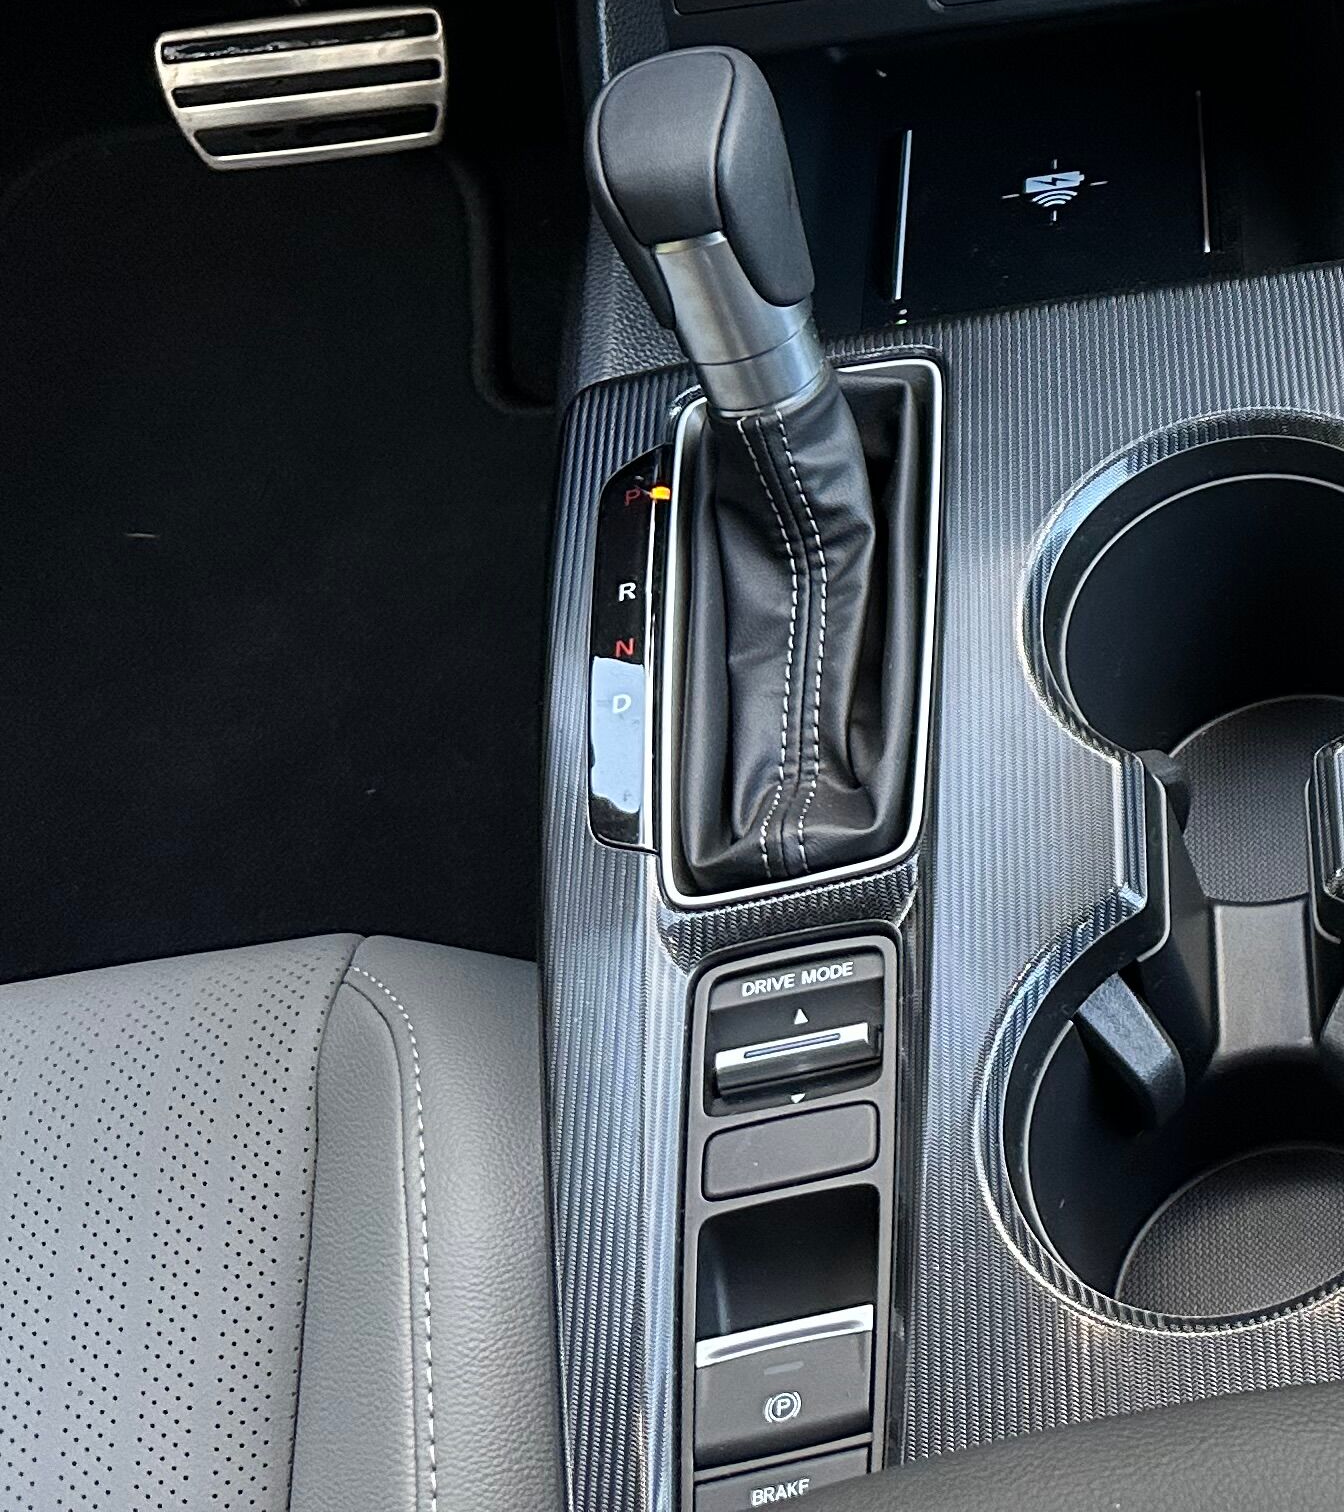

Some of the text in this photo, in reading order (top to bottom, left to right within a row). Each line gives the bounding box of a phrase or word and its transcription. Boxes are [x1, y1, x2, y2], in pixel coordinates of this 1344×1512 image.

[624, 488, 641, 506] P
[618, 582, 636, 602] R
[616, 637, 634, 657] N
[612, 694, 632, 714] D
[741, 961, 853, 997] DRIVE MODE
